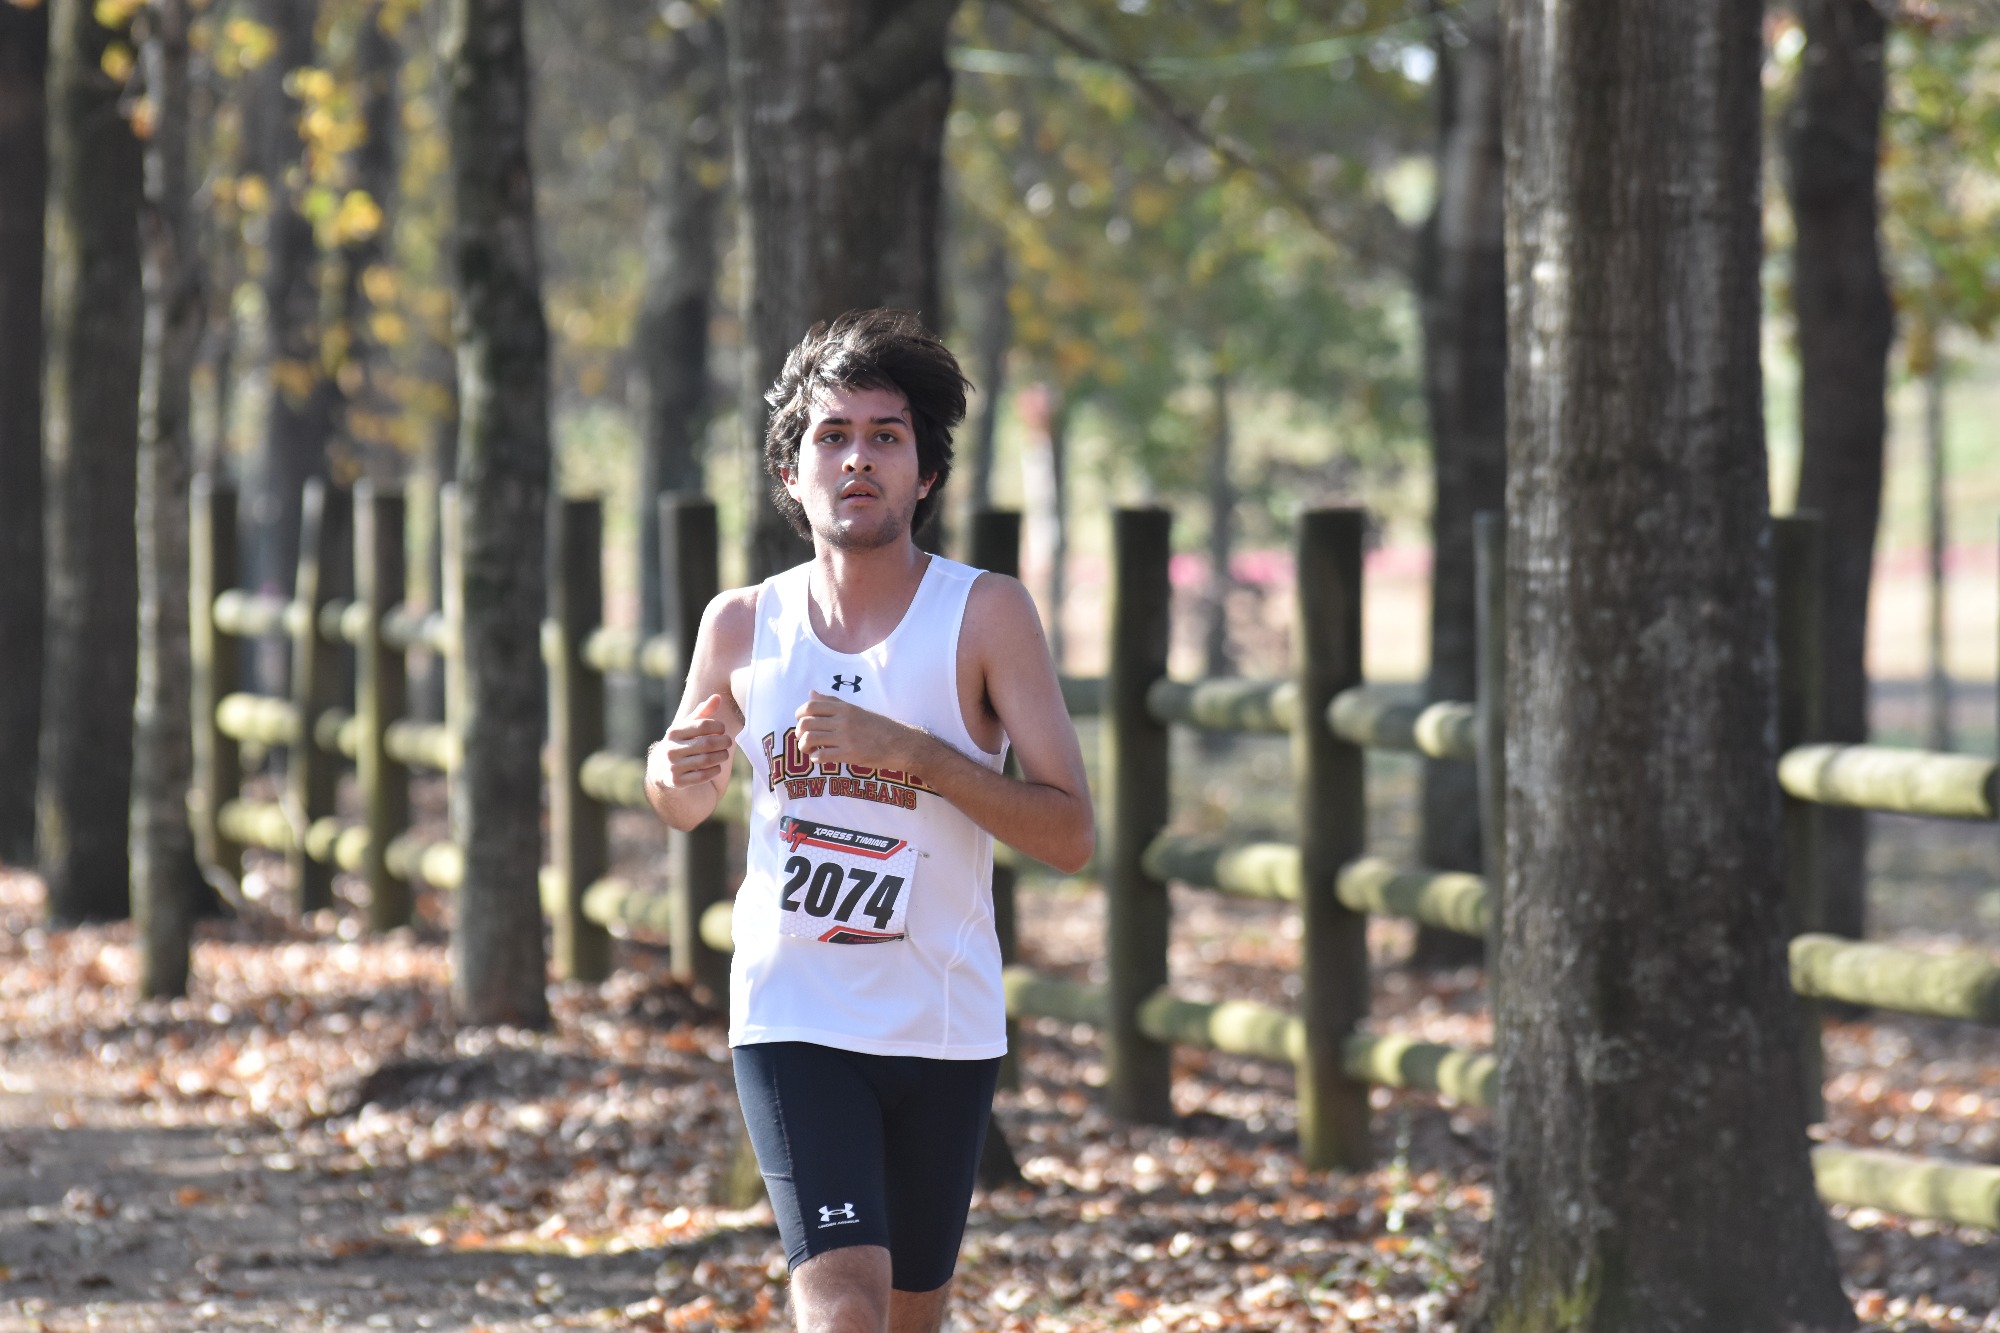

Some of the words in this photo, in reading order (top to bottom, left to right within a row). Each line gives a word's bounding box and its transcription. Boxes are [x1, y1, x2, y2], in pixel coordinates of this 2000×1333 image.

[784, 777, 827, 800] NEW
[828, 777, 917, 811] ORLEANS
[813, 827, 853, 841] XPRESS
[855, 835, 889, 848] TIMING
[780, 855, 905, 930] 2074
